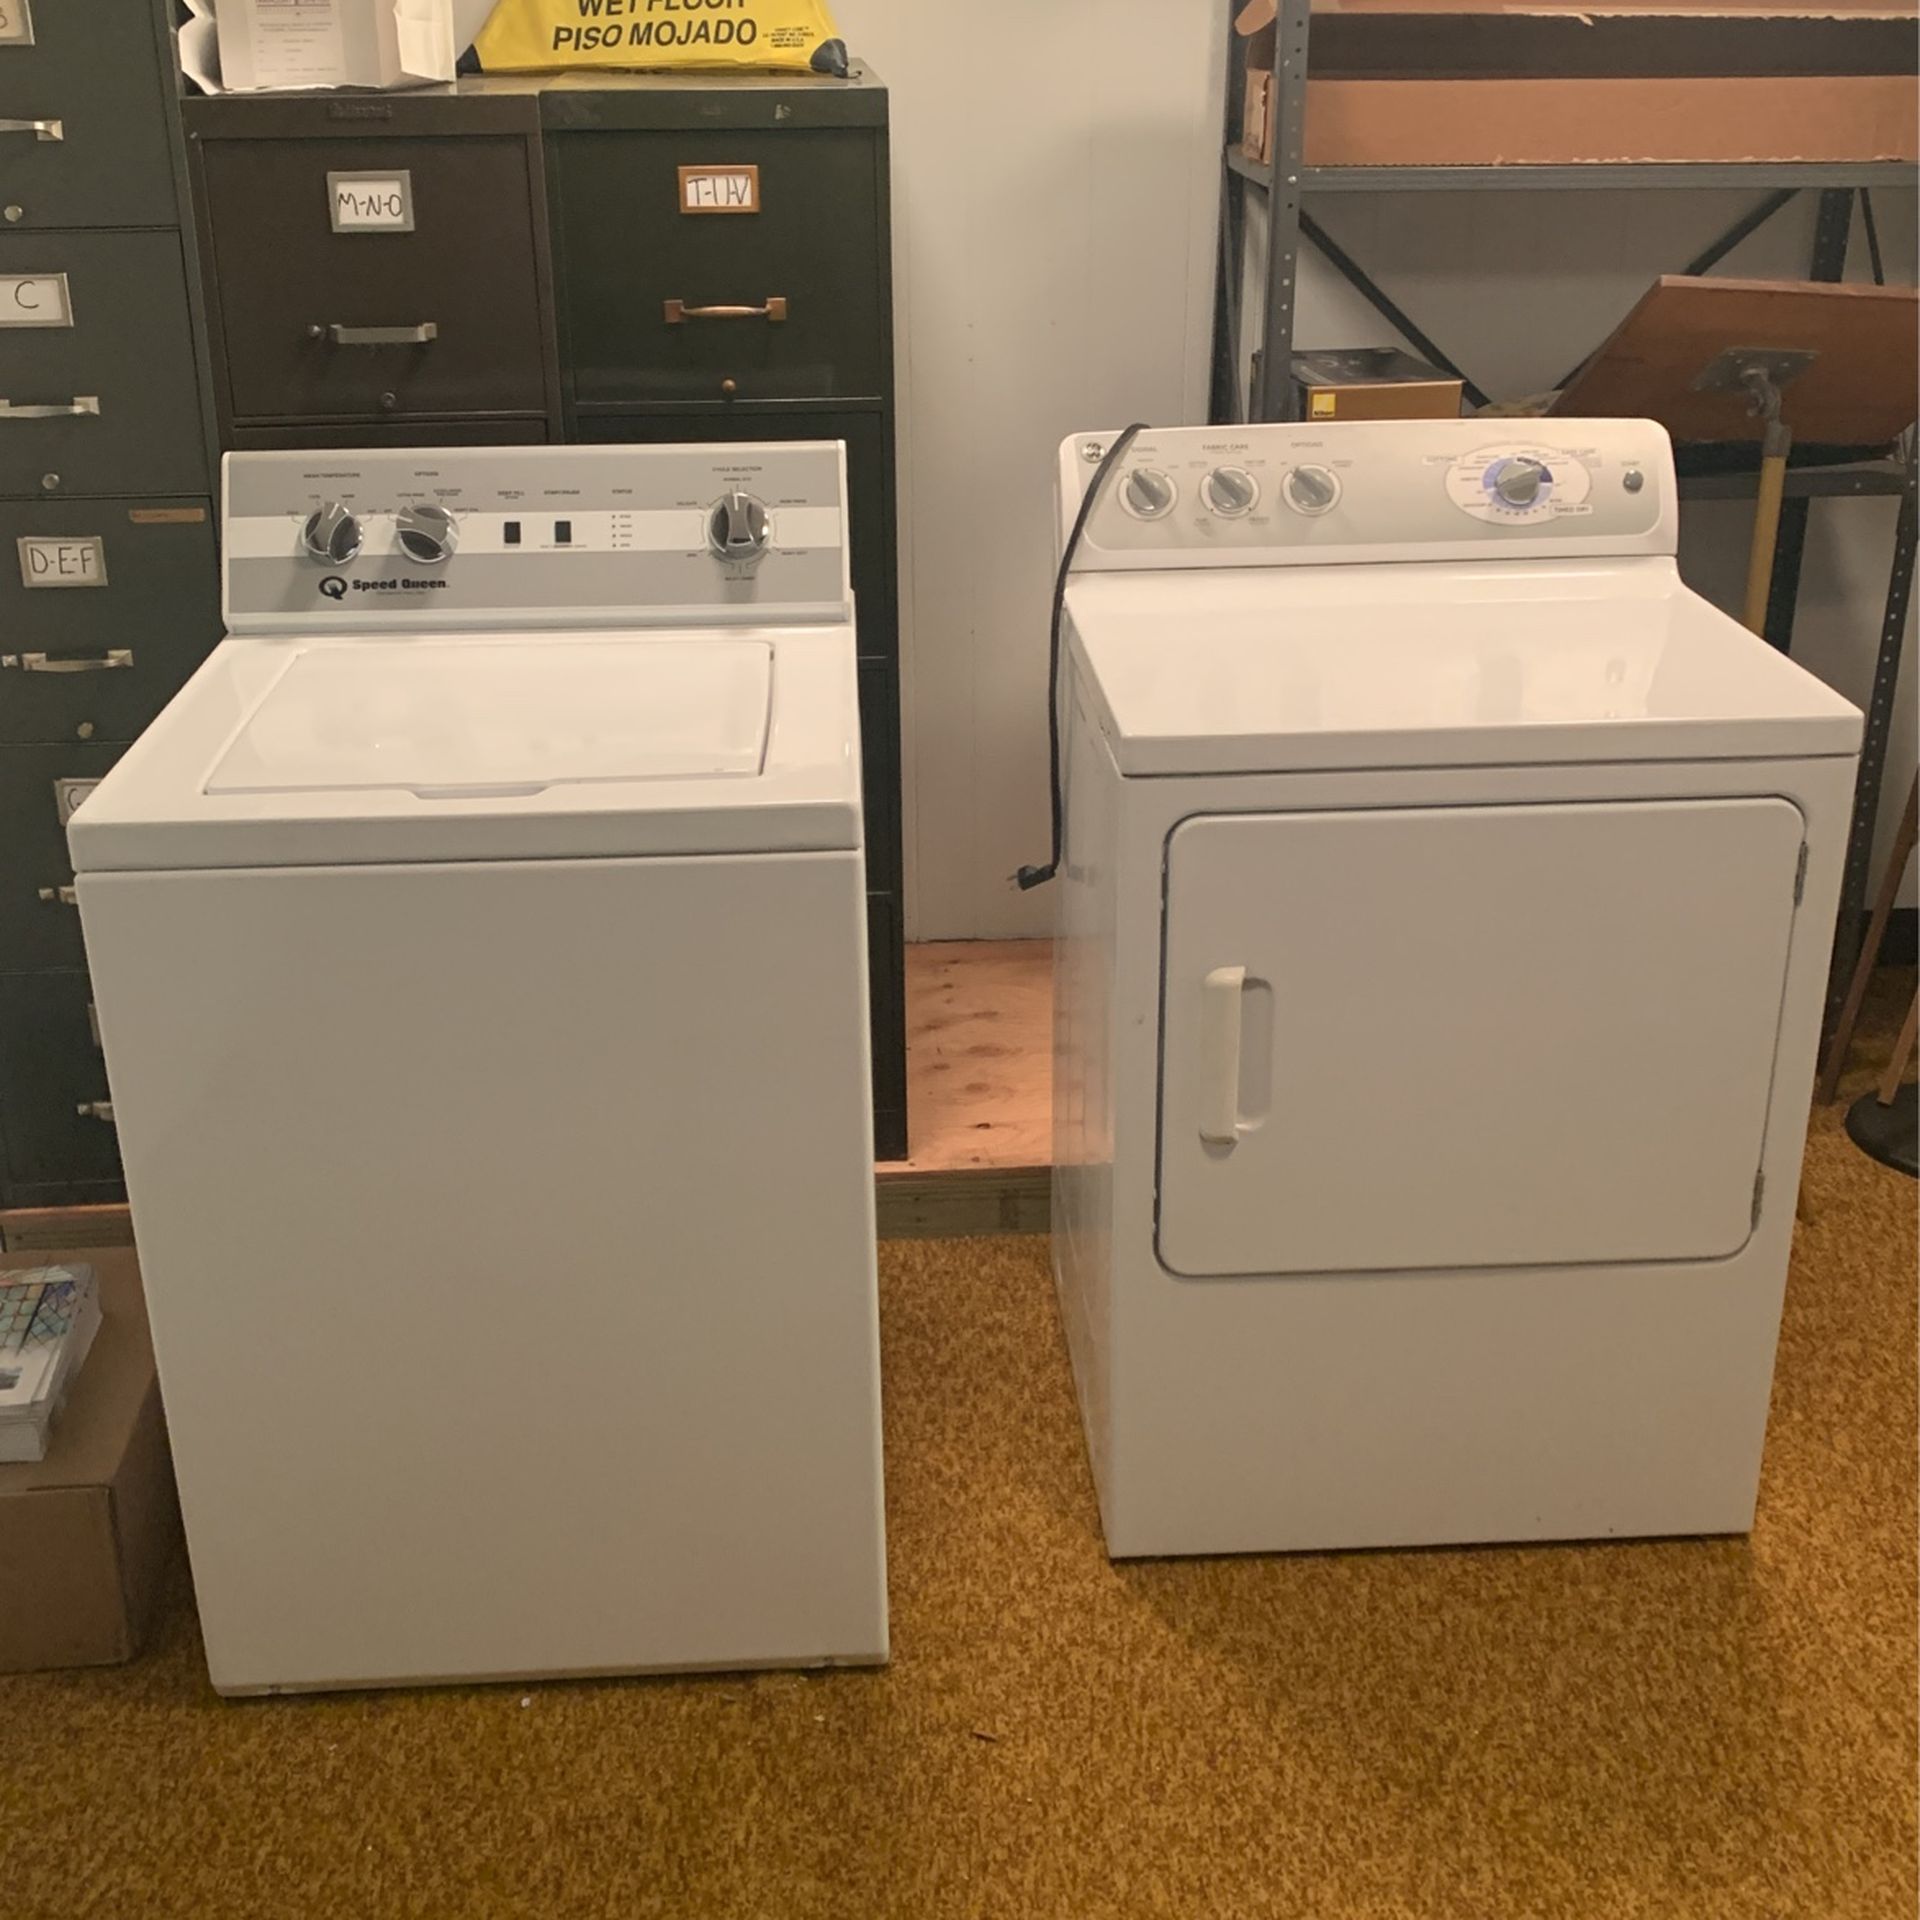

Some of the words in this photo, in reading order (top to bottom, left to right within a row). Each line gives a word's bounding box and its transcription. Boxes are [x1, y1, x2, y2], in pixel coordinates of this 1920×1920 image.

[552, 24, 623, 51] PISO
[628, 18, 757, 46] MOJADO
[337, 191, 403, 217] M-N-O
[14, 280, 40, 310] C
[29, 546, 95, 575] D-E-F
[352, 578, 398, 593] Speed
[401, 578, 447, 590] Queen
